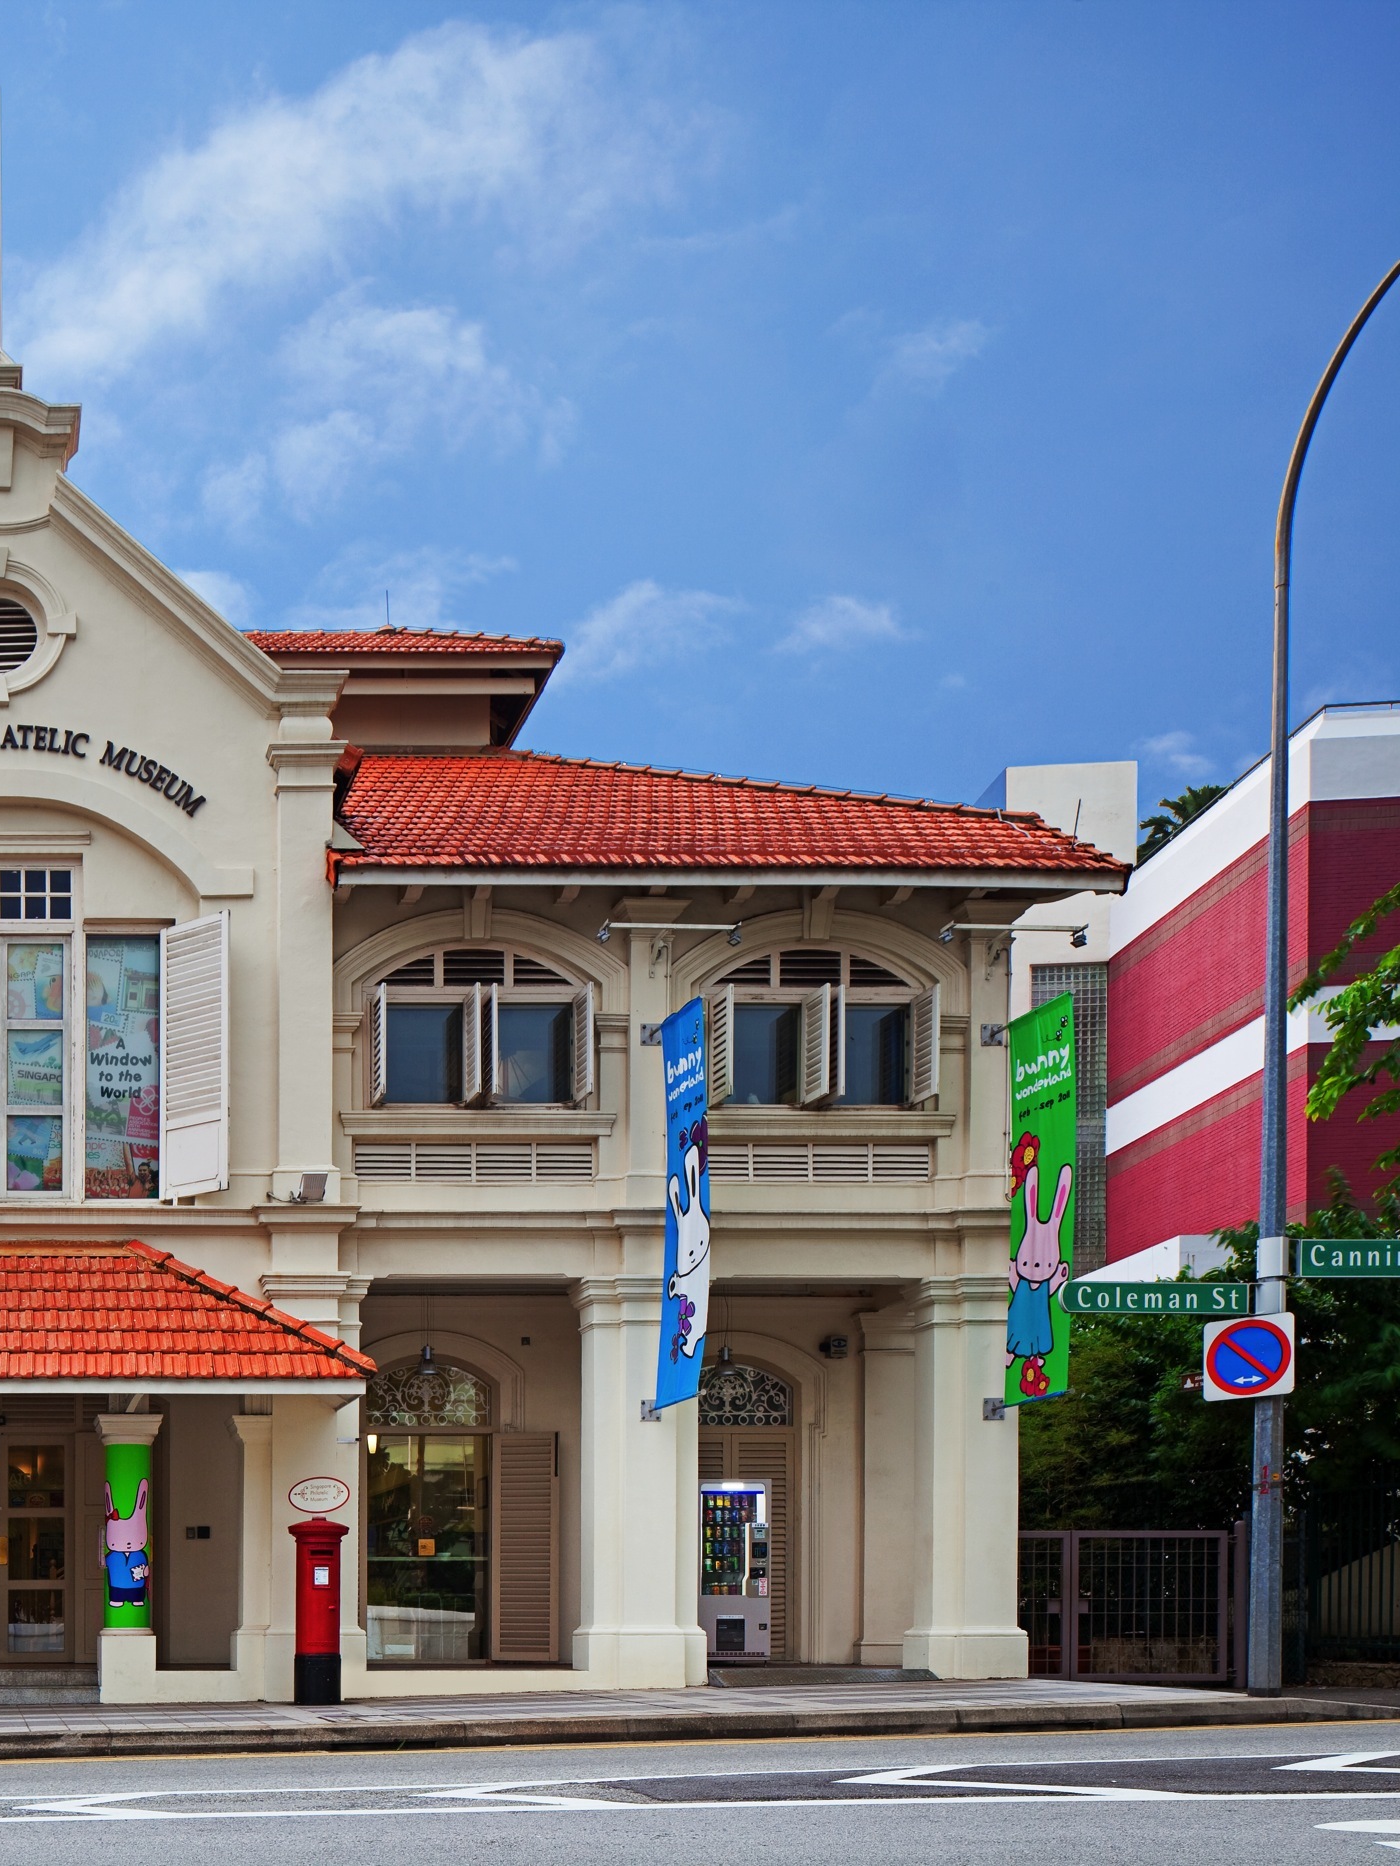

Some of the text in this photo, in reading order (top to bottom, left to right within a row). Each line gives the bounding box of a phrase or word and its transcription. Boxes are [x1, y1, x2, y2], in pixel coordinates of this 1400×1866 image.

[99, 740, 207, 818] MUSEUM
[116, 1038, 125, 1050] A
[91, 1052, 152, 1066] Window
[667, 1047, 702, 1084] bunny
[1016, 1043, 1070, 1082] bunny
[99, 1070, 142, 1082] to the
[669, 1067, 704, 1102] wonerland
[1016, 1063, 1072, 1101] wonderland
[101, 1086, 141, 1099] World
[684, 1102, 692, 1112] ep
[1019, 1107, 1030, 1123] feb
[1040, 1099, 1054, 1110] sep
[1058, 1090, 1070, 1103] 2011
[1311, 1245, 1400, 1266] Canni
[1078, 1287, 1240, 1310] Coleman St
